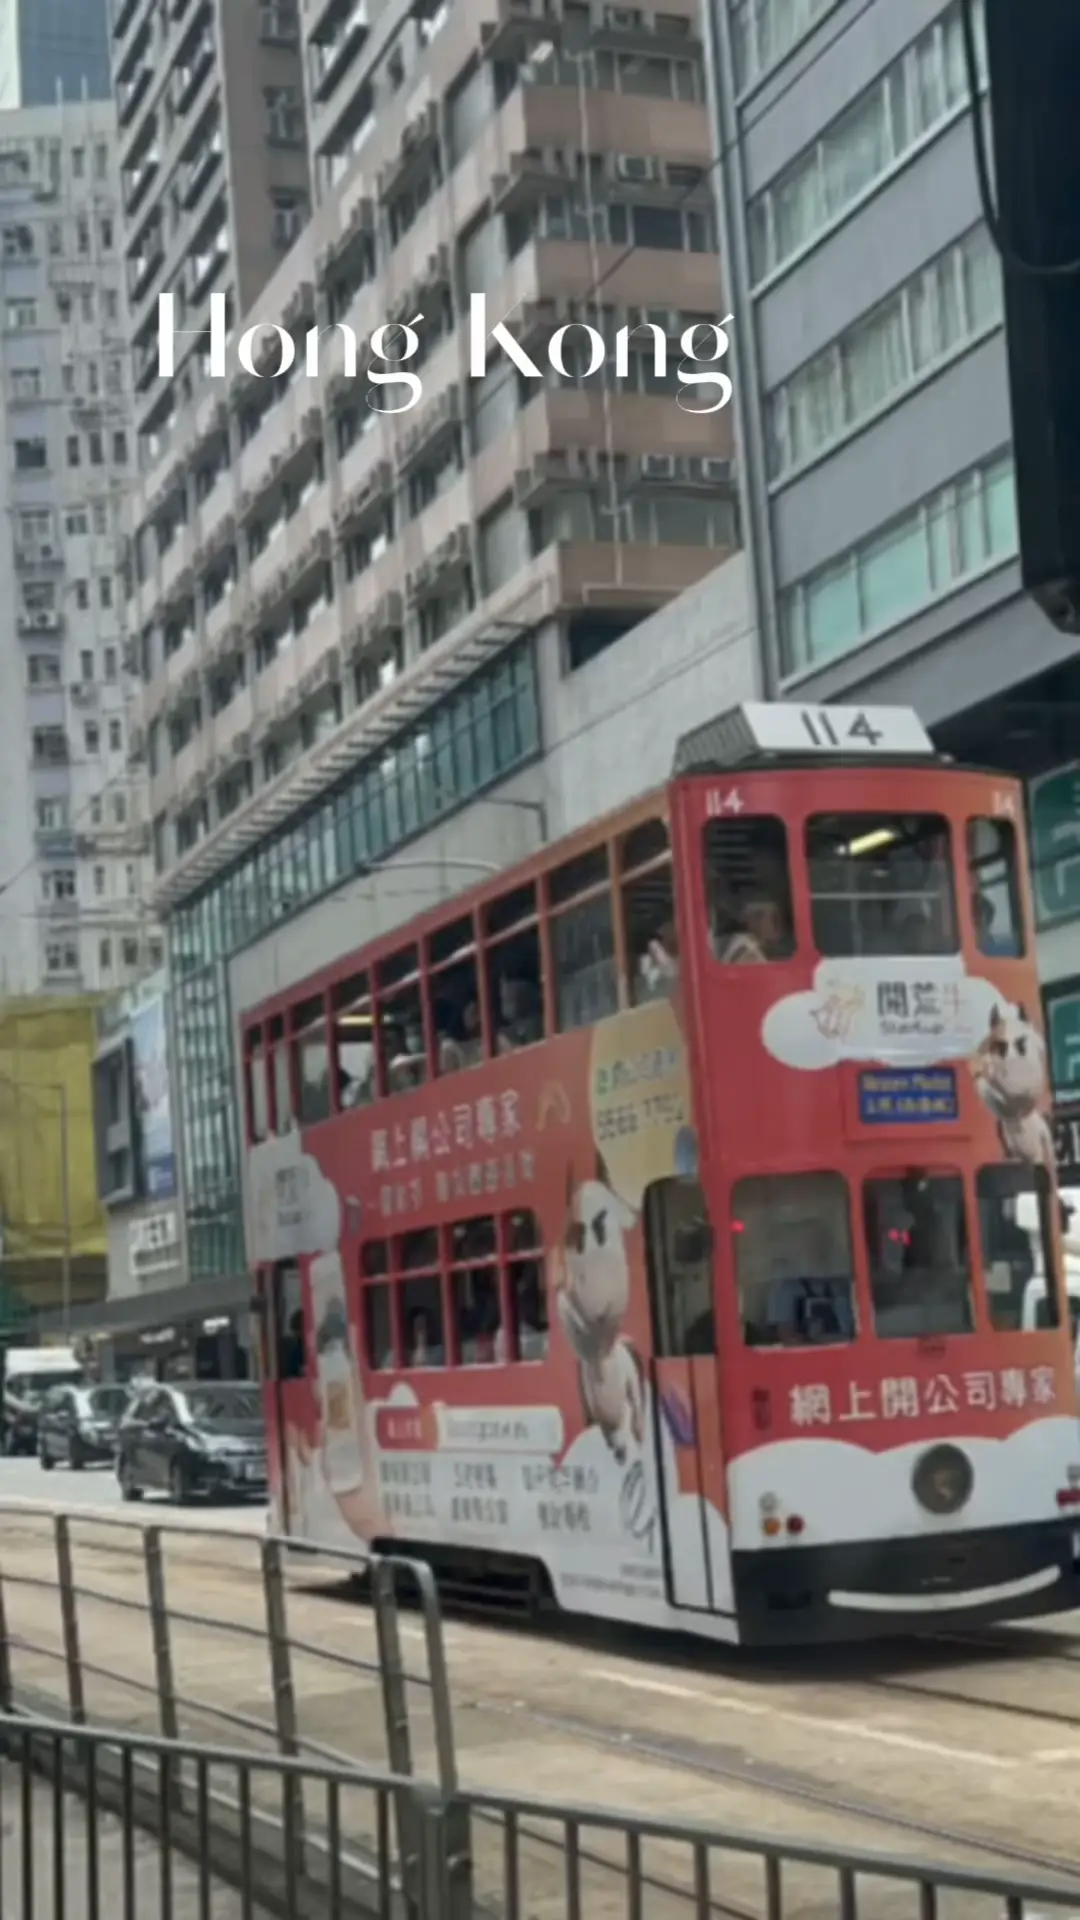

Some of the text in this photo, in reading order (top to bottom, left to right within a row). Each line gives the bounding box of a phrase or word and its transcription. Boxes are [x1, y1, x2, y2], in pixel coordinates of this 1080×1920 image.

[802, 711, 884, 747] 114
[705, 787, 746, 817] 114
[788, 1365, 1057, 1427] 網上開公司專家
